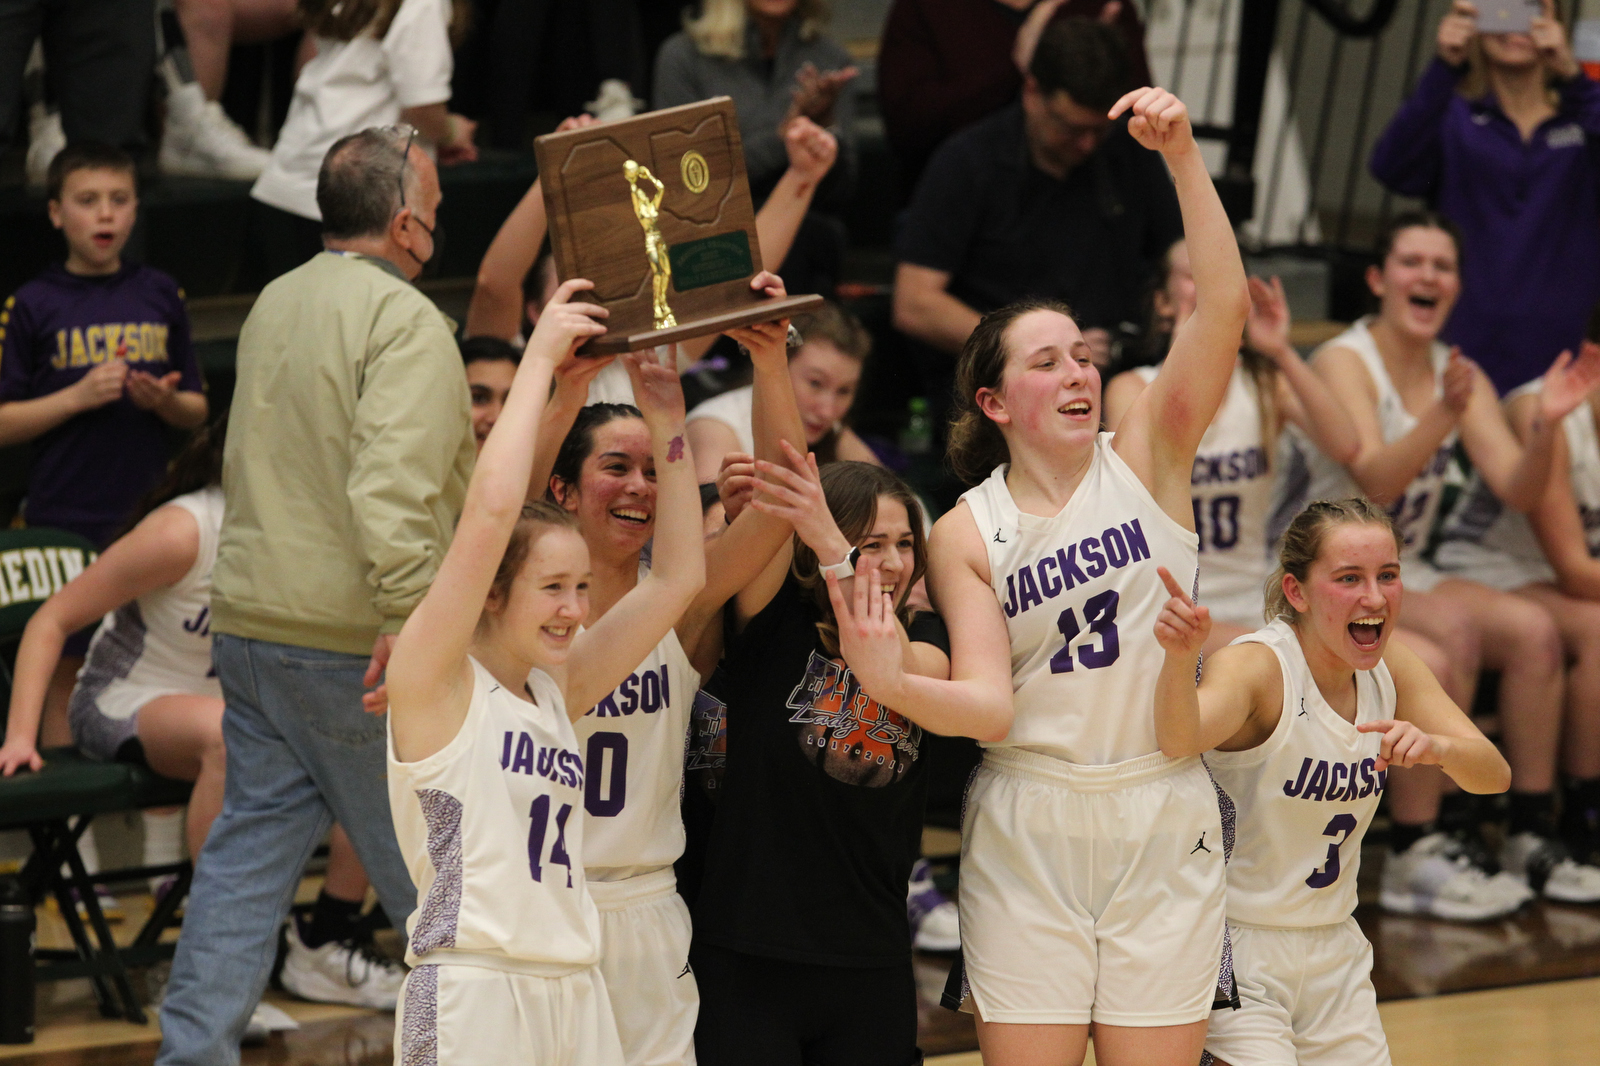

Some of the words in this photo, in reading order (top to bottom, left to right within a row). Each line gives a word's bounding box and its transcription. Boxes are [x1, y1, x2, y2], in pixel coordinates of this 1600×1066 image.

[0, 546, 98, 608] EDIN
[1003, 518, 1151, 618] JACKSON
[1050, 589, 1120, 674] 13
[789, 701, 860, 739] Lady
[584, 731, 629, 817] 0
[1283, 753, 1387, 802] JACKS
[528, 794, 573, 888] 14
[1305, 813, 1358, 889] 3
